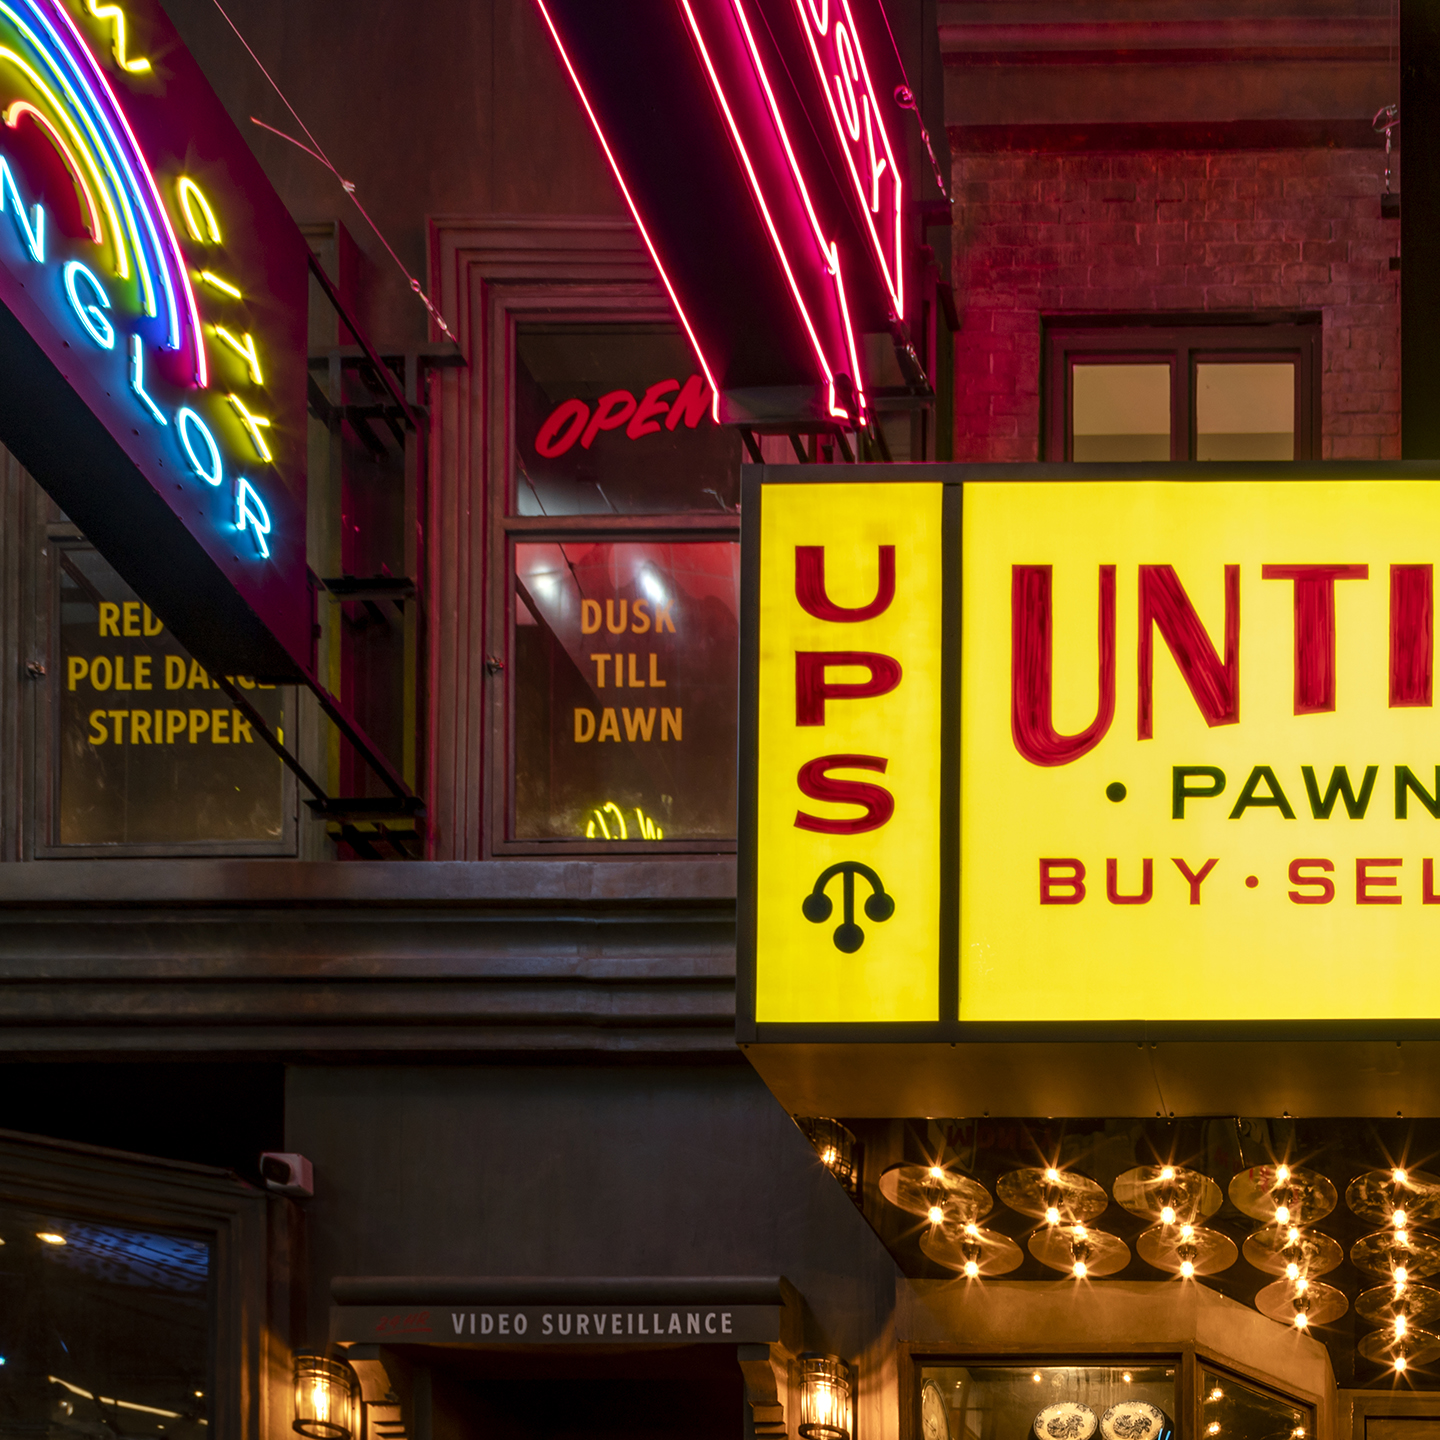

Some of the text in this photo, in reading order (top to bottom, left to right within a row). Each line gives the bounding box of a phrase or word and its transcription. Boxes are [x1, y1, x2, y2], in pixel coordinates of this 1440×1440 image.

[534, 374, 713, 460] OPEN
[99, 601, 165, 637] RED
[581, 600, 677, 635] DUSK
[67, 654, 153, 691] POLE
[591, 653, 667, 688] TILL
[793, 545, 903, 835] UPS
[88, 709, 254, 745] STRIPPER
[574, 707, 682, 743] DAWN
[1039, 857, 1220, 905] BUY
[452, 1312, 529, 1335] VIDEO
[541, 1312, 733, 1335] SURVEILLANCE
